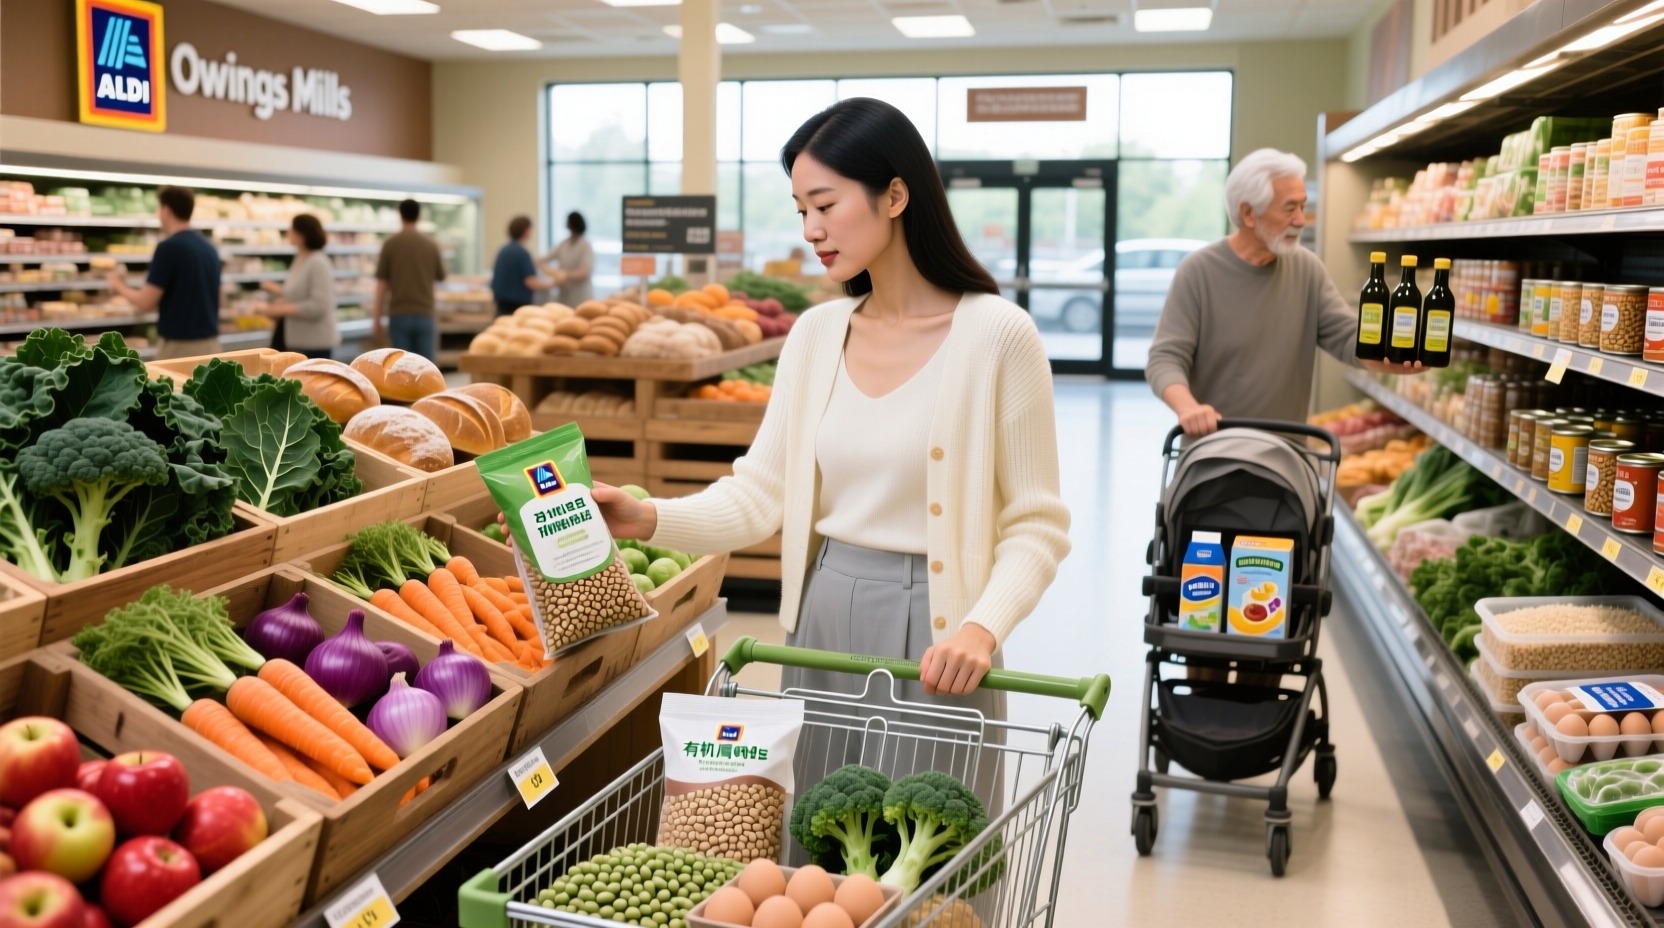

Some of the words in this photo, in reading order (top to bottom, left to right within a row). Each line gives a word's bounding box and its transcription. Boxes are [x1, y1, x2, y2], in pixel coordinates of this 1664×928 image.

[97, 73, 150, 104] ALDI
[170, 42, 289, 120] Owings
[292, 67, 352, 120] Mills
